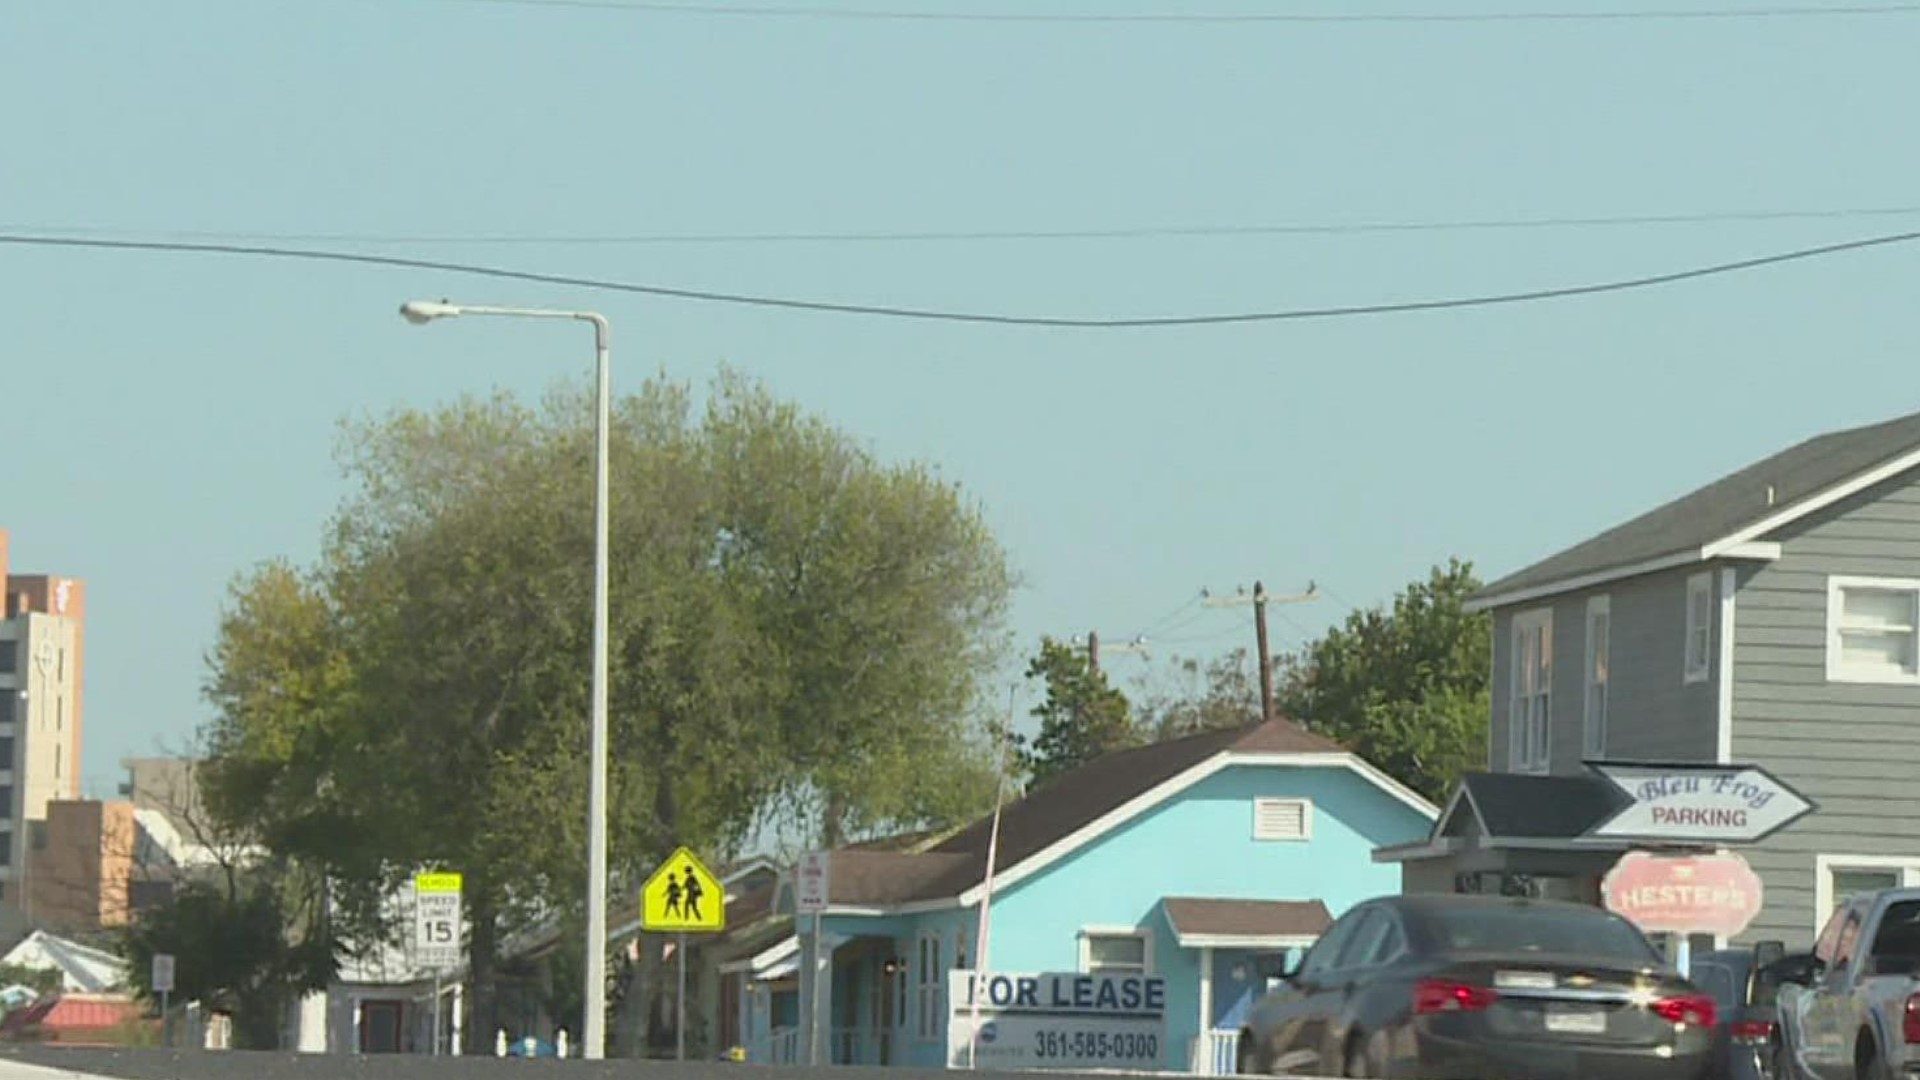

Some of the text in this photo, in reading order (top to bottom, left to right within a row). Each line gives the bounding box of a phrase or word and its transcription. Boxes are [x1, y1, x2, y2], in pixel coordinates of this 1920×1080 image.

[1637, 773, 1776, 809] Bleu Frog
[1652, 806, 1748, 827] PARKING
[425, 921, 453, 942] 15
[1052, 976, 1165, 1010] LEASE
[1035, 1030, 1158, 1059] 361-585-0300
